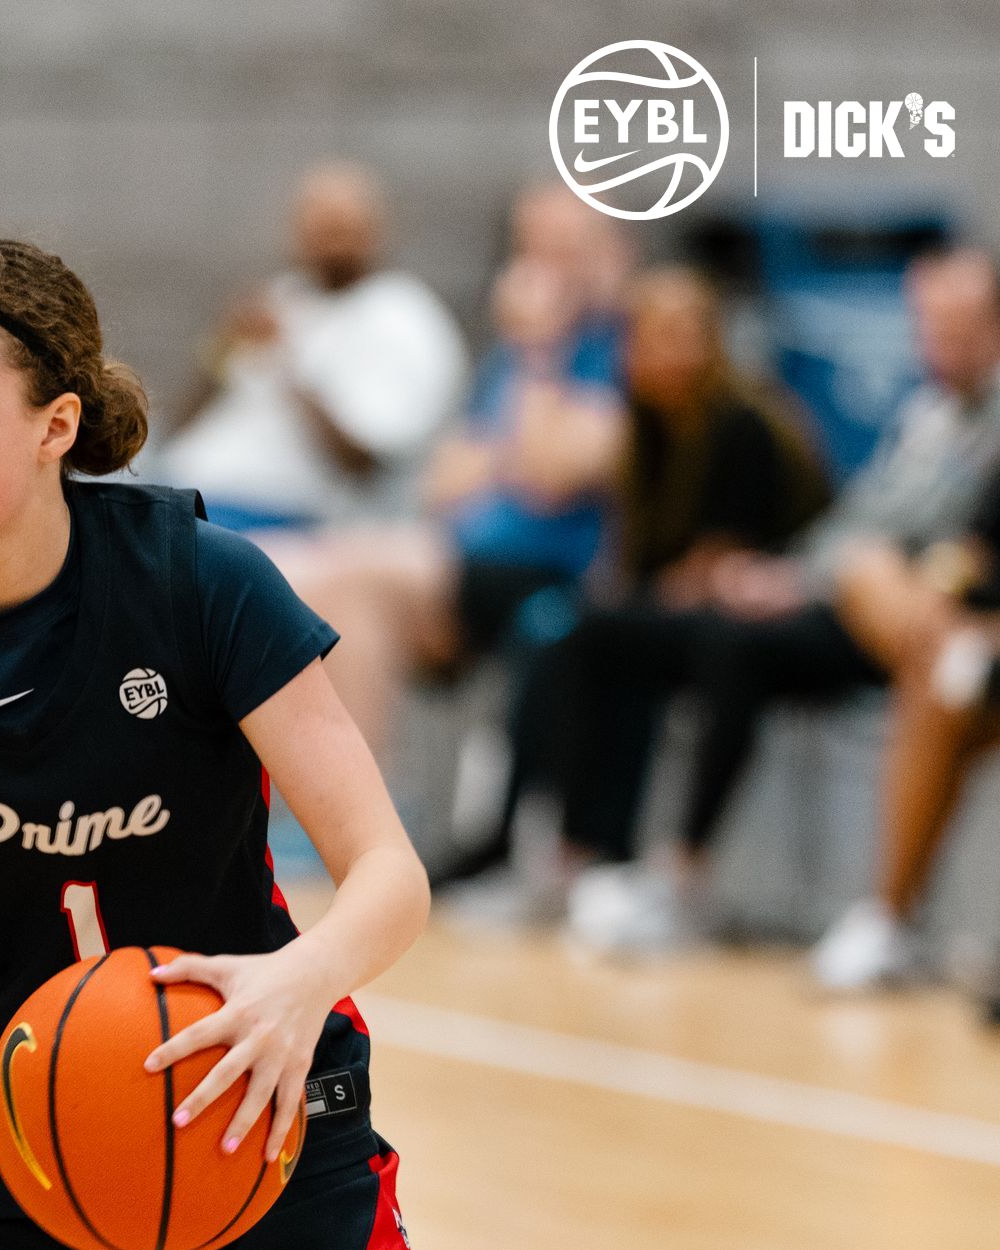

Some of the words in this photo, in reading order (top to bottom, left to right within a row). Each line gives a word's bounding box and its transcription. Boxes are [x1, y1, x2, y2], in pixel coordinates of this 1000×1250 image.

[124, 681, 164, 702] EYBL
[60, 880, 111, 962] 1
[334, 1084, 346, 1101] S
